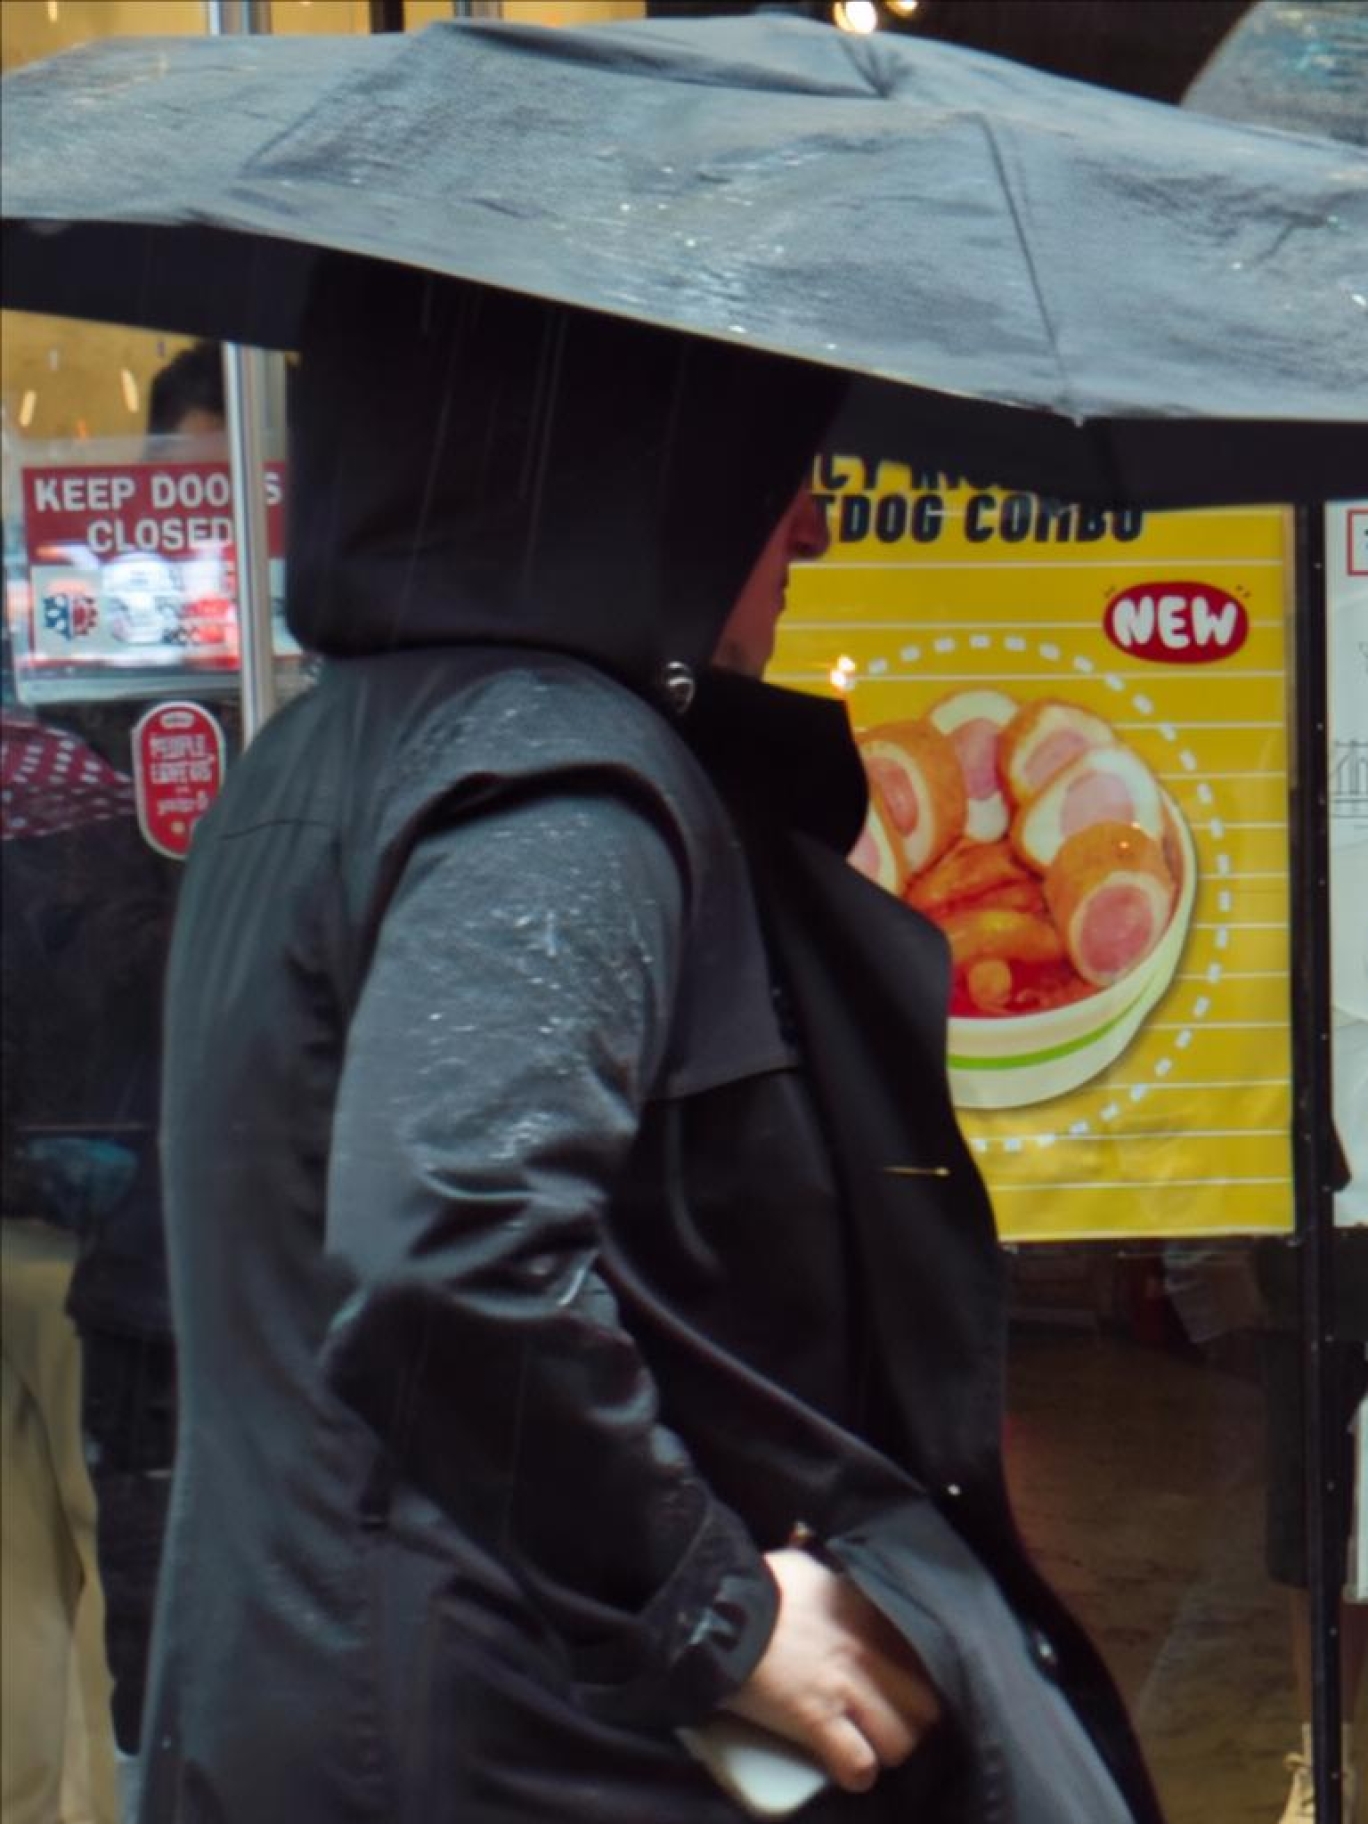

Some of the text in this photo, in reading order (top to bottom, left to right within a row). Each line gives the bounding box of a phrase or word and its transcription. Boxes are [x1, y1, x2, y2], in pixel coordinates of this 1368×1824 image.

[34, 472, 283, 513] KEEP DOOS
[86, 516, 233, 554] CLOSED
[964, 493, 1144, 544] COMBO
[1112, 595, 1237, 650] NEW
